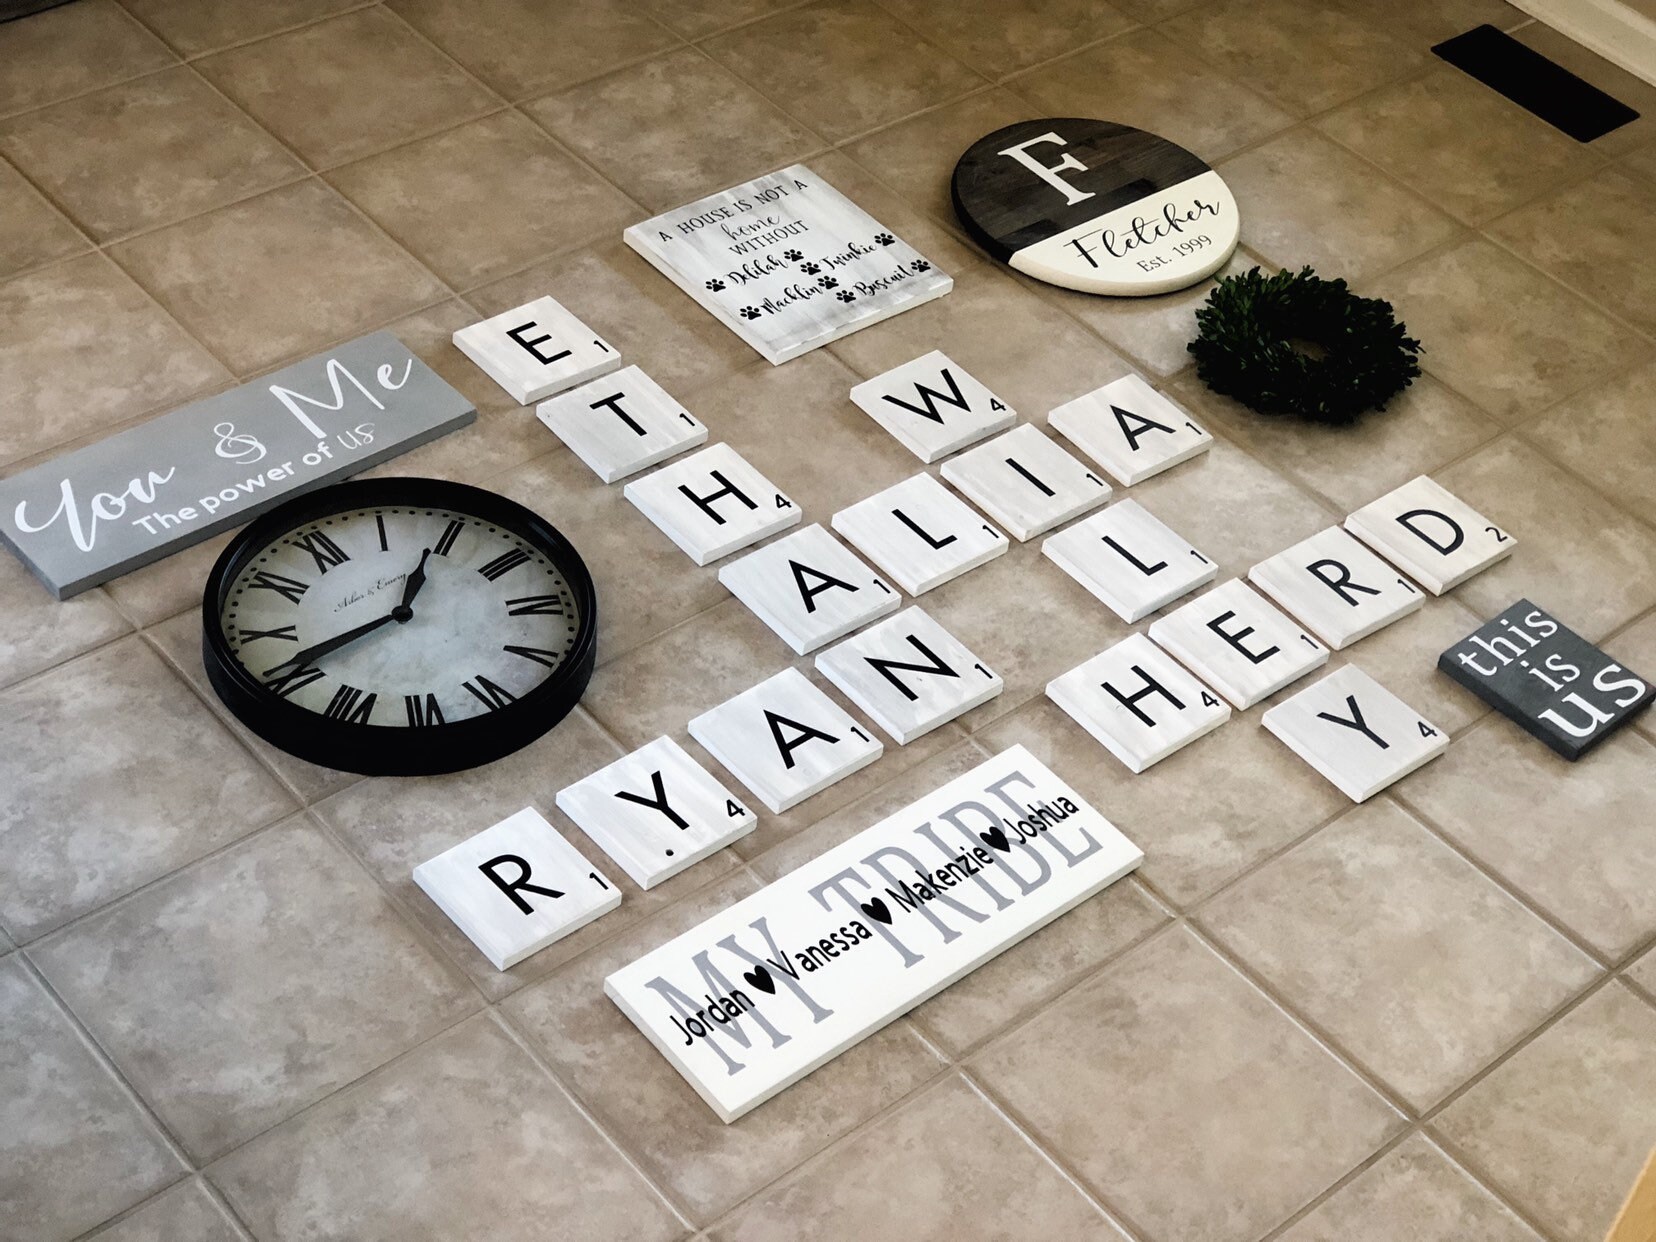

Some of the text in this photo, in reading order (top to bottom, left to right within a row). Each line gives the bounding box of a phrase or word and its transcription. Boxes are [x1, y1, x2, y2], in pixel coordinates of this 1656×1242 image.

[997, 132, 1096, 206] F
[658, 179, 808, 243] A HOUSE IS NOT A
[721, 213, 780, 241] home
[728, 220, 809, 256] WITHOUT
[1063, 200, 1220, 268] Fletcher
[727, 242, 877, 286] Delilah Twinkie
[1136, 234, 1212, 272] Est. 1999
[760, 285, 823, 315] Macklin
[506, 321, 573, 366] E
[589, 392, 648, 437] T
[881, 368, 972, 425] W
[14, 358, 412, 552] You & Me
[1110, 405, 1176, 451] A
[132, 505, 198, 537] The
[198, 461, 295, 514] power
[302, 441, 334, 465] of
[677, 470, 759, 526] H
[1005, 457, 1056, 497] I
[891, 508, 958, 550] L
[1101, 535, 1168, 576] L
[1395, 509, 1464, 556] D
[788, 559, 860, 614] A
[1306, 559, 1381, 607] R
[1206, 610, 1281, 665] E
[1458, 611, 1558, 676] this
[863, 634, 960, 702] N
[1520, 654, 1580, 692] is
[1100, 665, 1187, 728] H
[1316, 695, 1390, 750] Y
[1538, 664, 1646, 737] us
[763, 709, 841, 770] A
[614, 770, 690, 831] Y
[478, 854, 566, 916] R
[644, 770, 1104, 1076] MY TRIBE
[668, 795, 1080, 1046] Jordan Vanessa Makenzie Joshua
